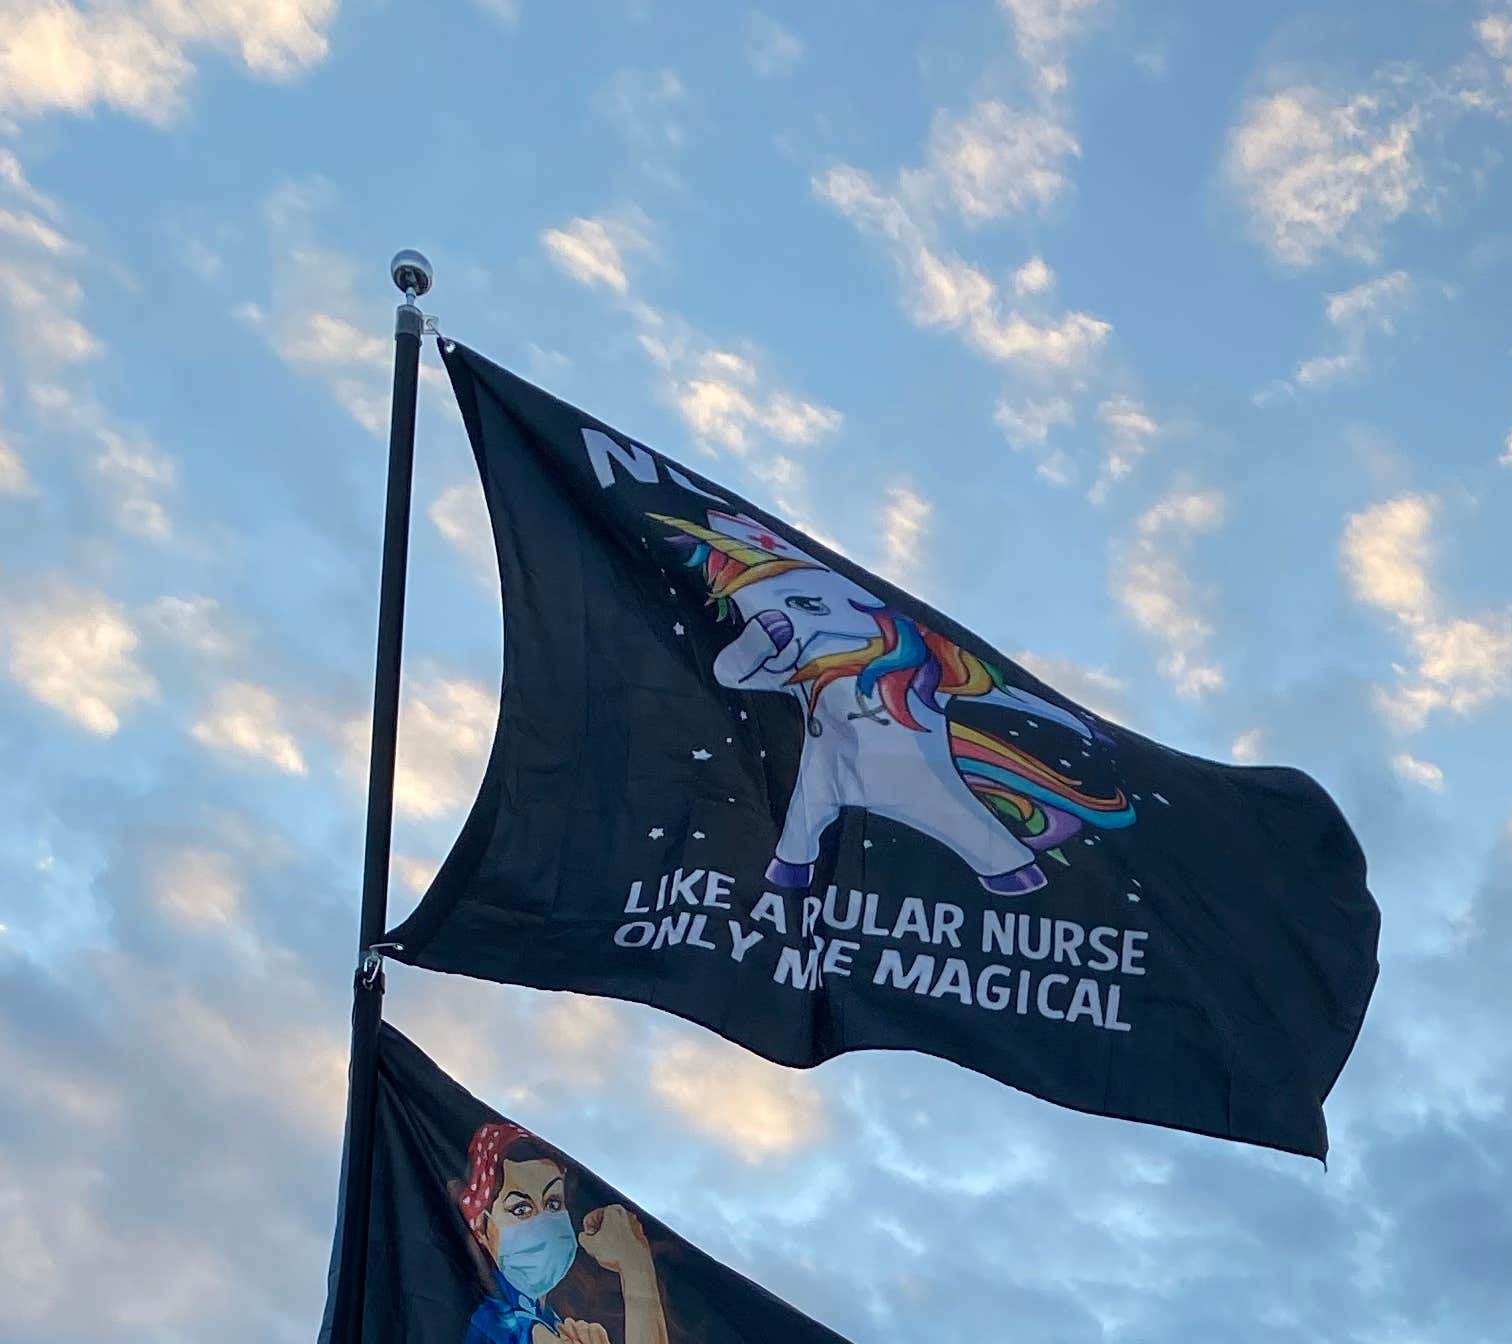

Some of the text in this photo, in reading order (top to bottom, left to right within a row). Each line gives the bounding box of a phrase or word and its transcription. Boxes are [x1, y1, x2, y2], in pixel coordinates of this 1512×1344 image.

[613, 911, 765, 963] ONLY
[872, 949, 1133, 1033] MAGICAL
[623, 867, 736, 914] LIKE
[750, 891, 788, 935] A
[981, 908, 1150, 976] NURSE
